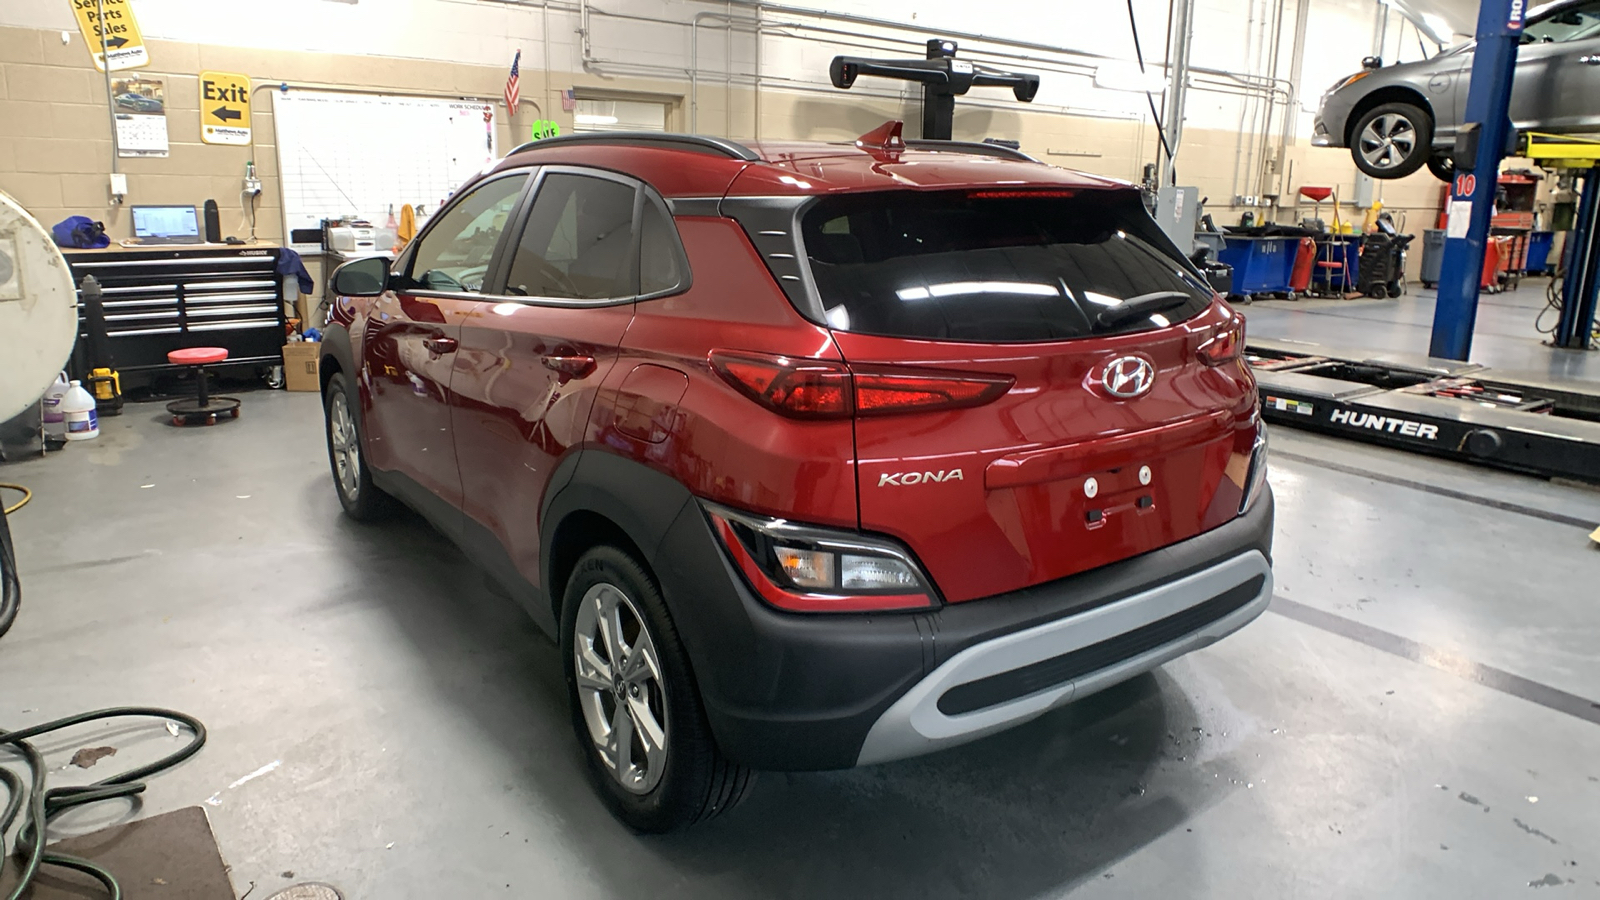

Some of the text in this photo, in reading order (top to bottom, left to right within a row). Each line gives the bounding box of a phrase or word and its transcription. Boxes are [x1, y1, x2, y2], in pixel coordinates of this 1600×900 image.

[74, 0, 124, 9] Seric
[203, 80, 247, 103] Exit
[1457, 174, 1476, 197] 10
[1330, 409, 1439, 439] HUNTER
[878, 468, 964, 487] KONA
